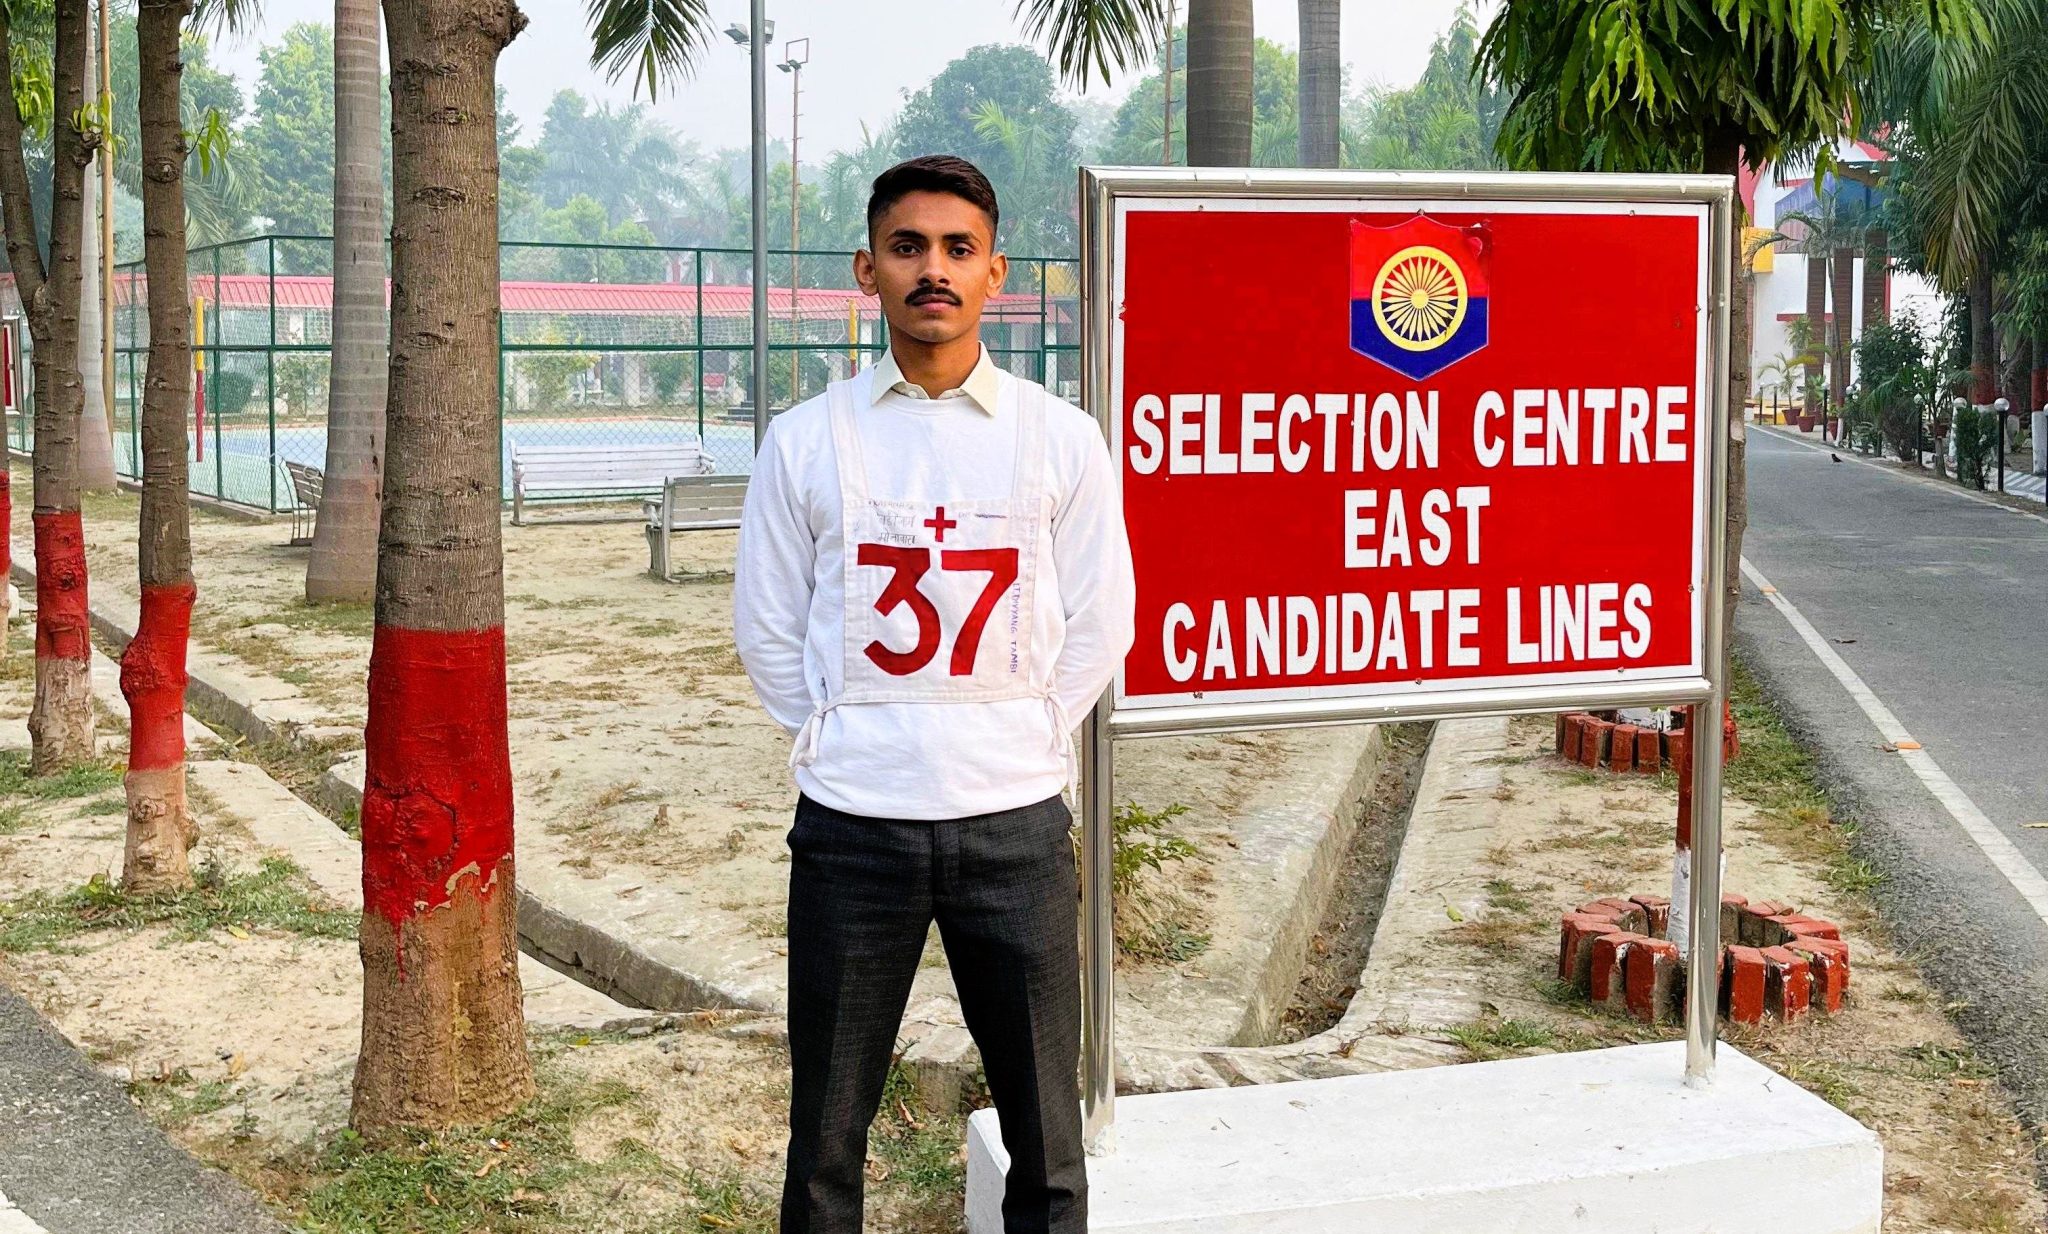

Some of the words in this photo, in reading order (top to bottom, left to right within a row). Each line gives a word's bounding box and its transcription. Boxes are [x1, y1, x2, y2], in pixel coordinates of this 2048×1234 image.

[1129, 390, 1438, 475] SELECTION
[1473, 386, 1688, 468] CENTRE
[1344, 486, 1491, 569] EAST
[857, 543, 1019, 675] 37
[1162, 588, 1480, 683] CANDIDATE
[1506, 582, 1652, 664] LINES
[1009, 640, 1018, 673] TAMBI
